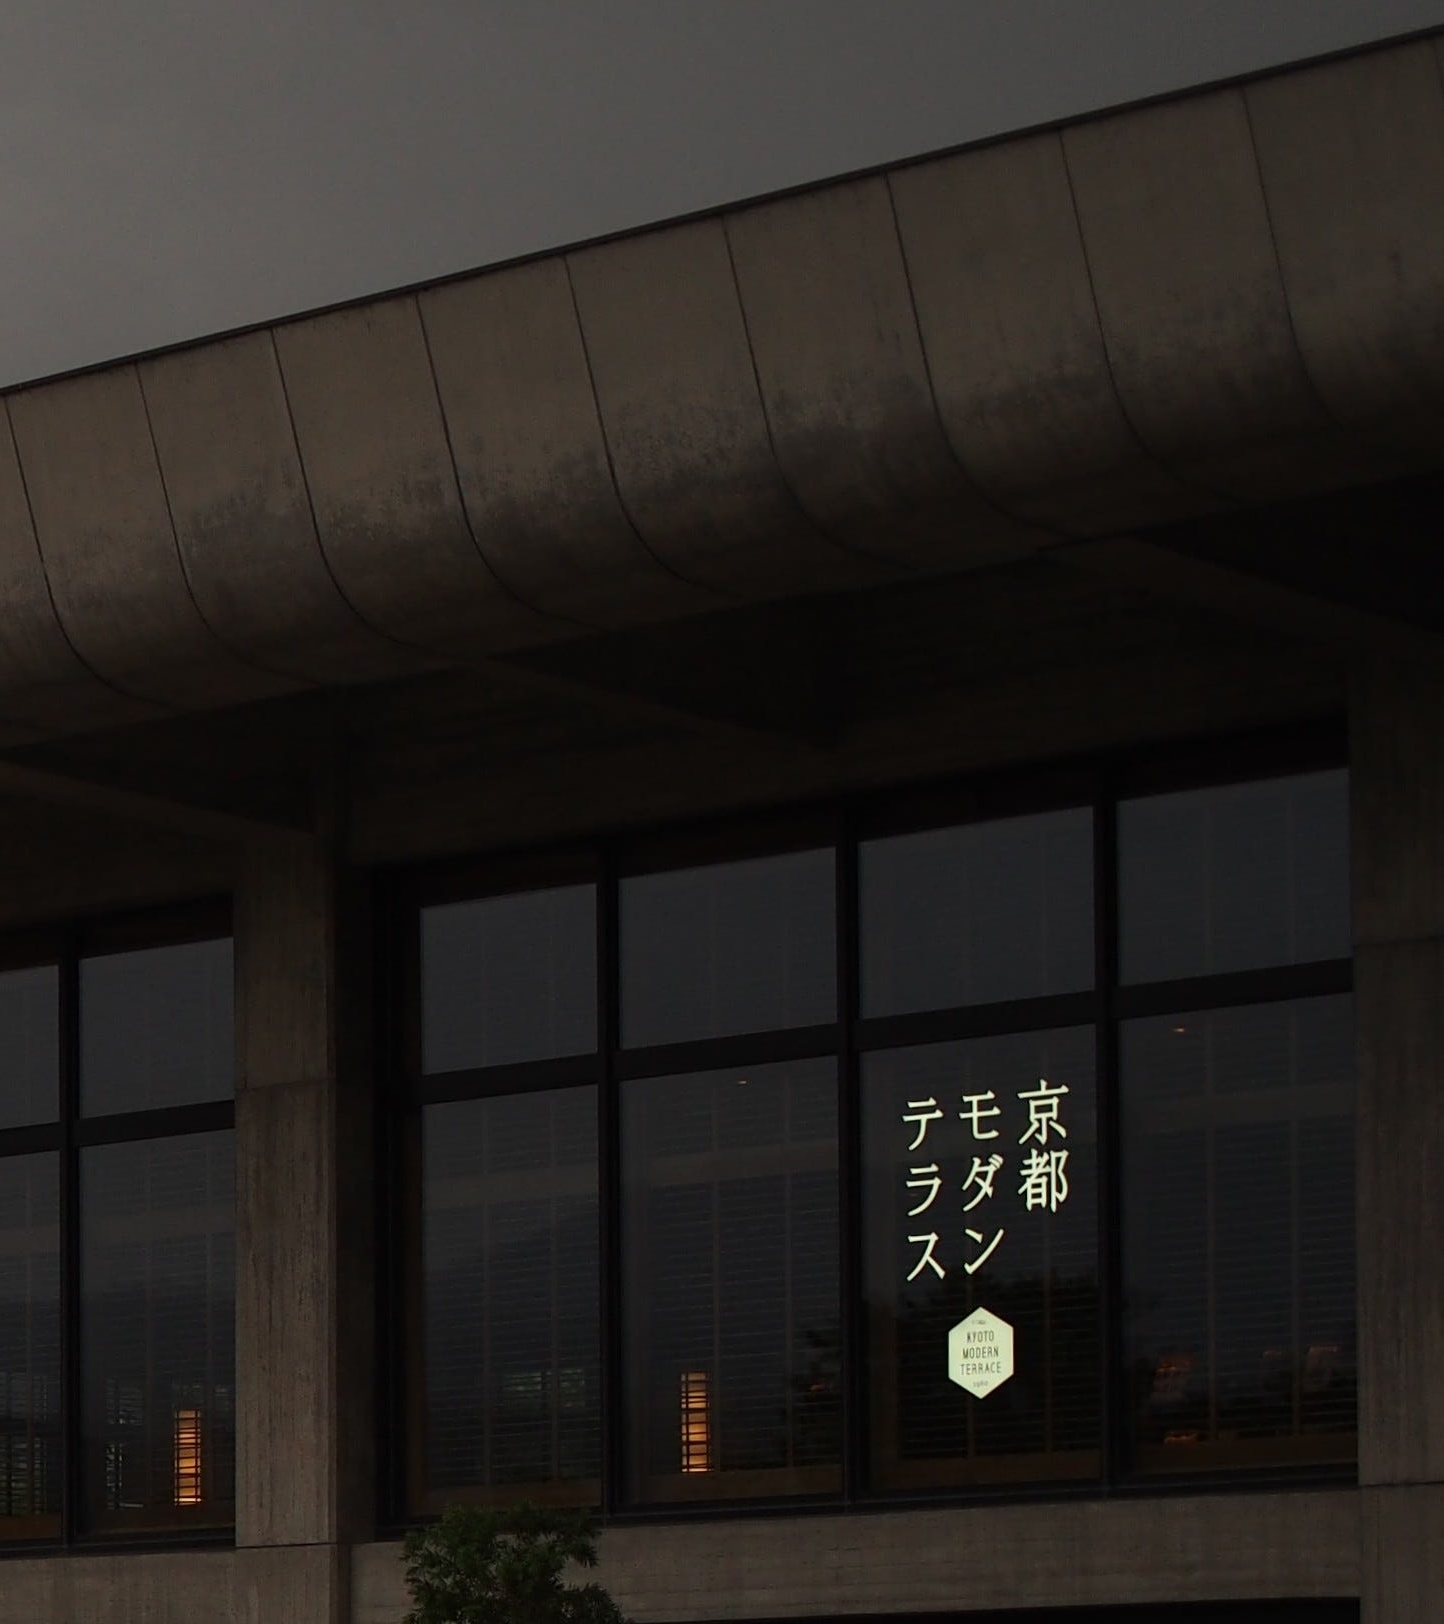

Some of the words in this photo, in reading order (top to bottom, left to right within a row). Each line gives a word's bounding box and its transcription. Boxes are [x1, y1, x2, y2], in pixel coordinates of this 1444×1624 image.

[958, 1089, 1005, 1275] モダン
[1017, 1079, 1070, 1213] 京都
[902, 1097, 946, 1282] テラス
[960, 1361, 1002, 1376] TERRACE
[962, 1346, 999, 1360] MODERN
[966, 1330, 995, 1344] KYOTO
